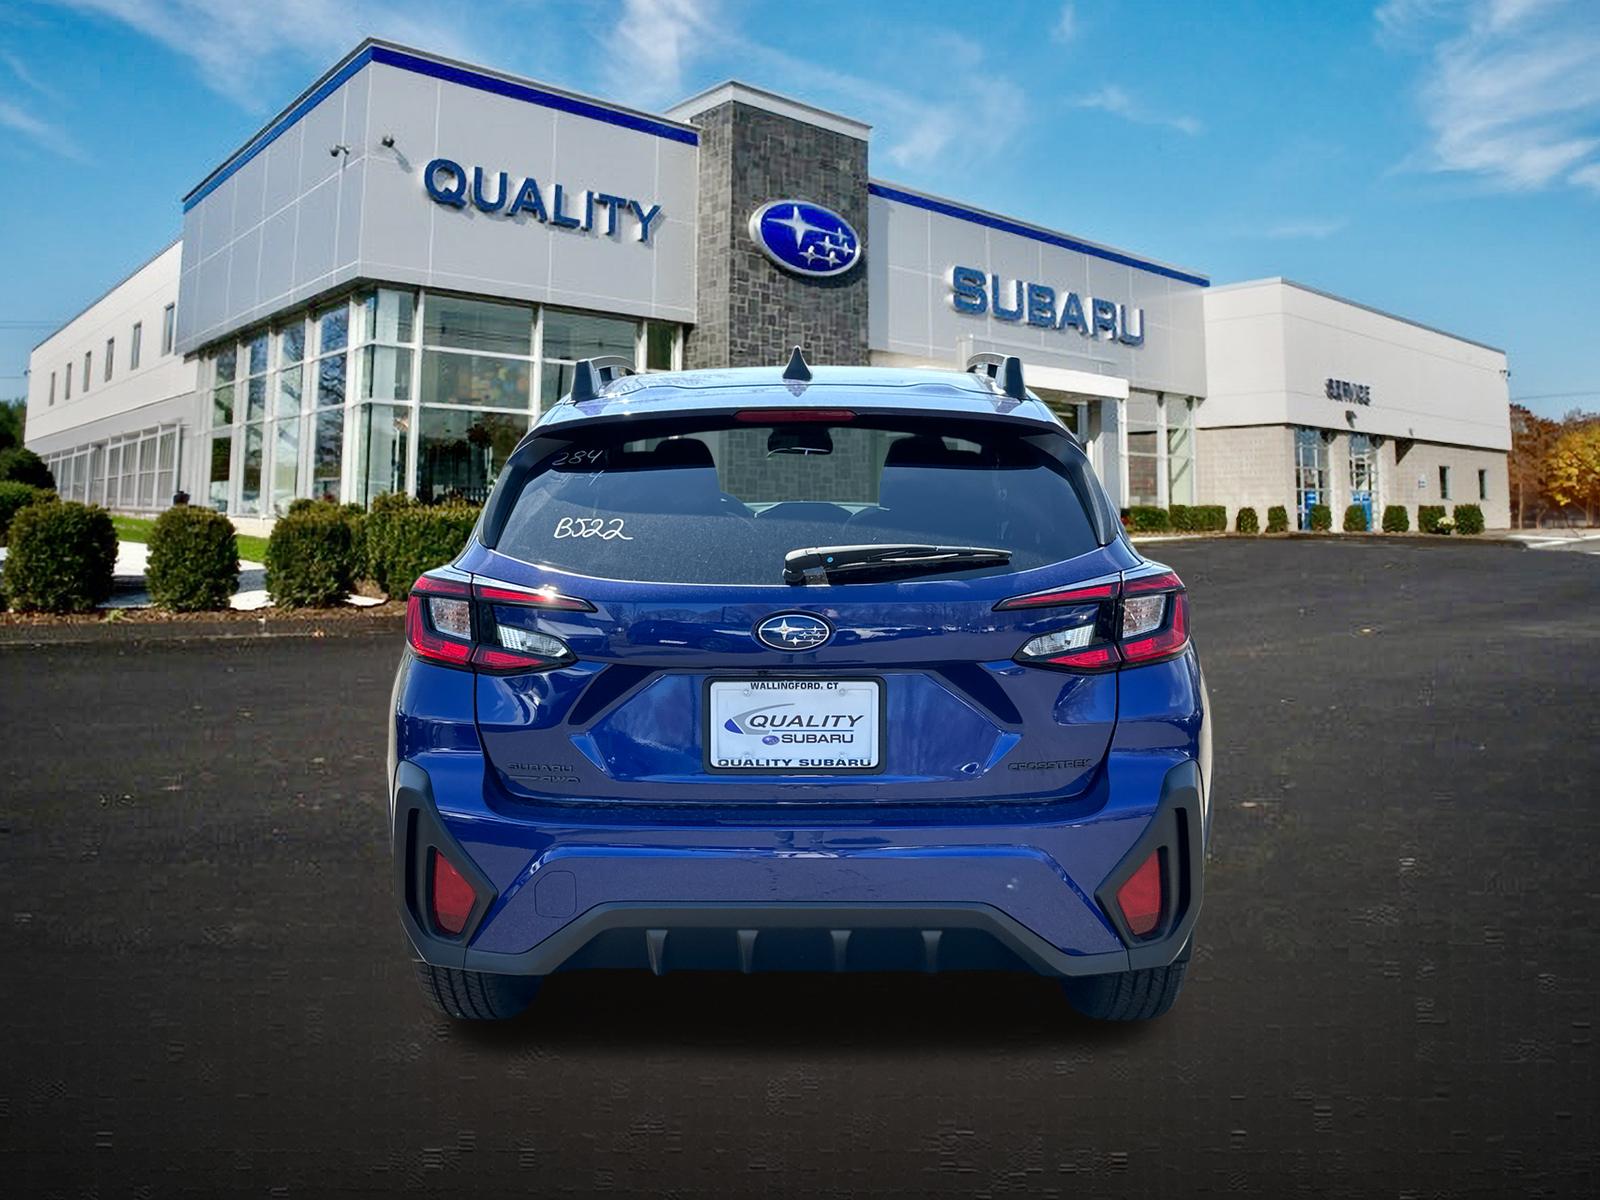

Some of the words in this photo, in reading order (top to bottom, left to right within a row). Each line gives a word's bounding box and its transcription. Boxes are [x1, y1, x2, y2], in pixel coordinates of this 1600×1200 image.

[424, 158, 661, 244] QUALITY
[948, 265, 1145, 347] SUBARU
[551, 449, 604, 466] 284
[826, 682, 839, 690] CT
[749, 715, 864, 728] QUALITY
[781, 734, 854, 743] SUBARU
[508, 763, 575, 772] SUBARU
